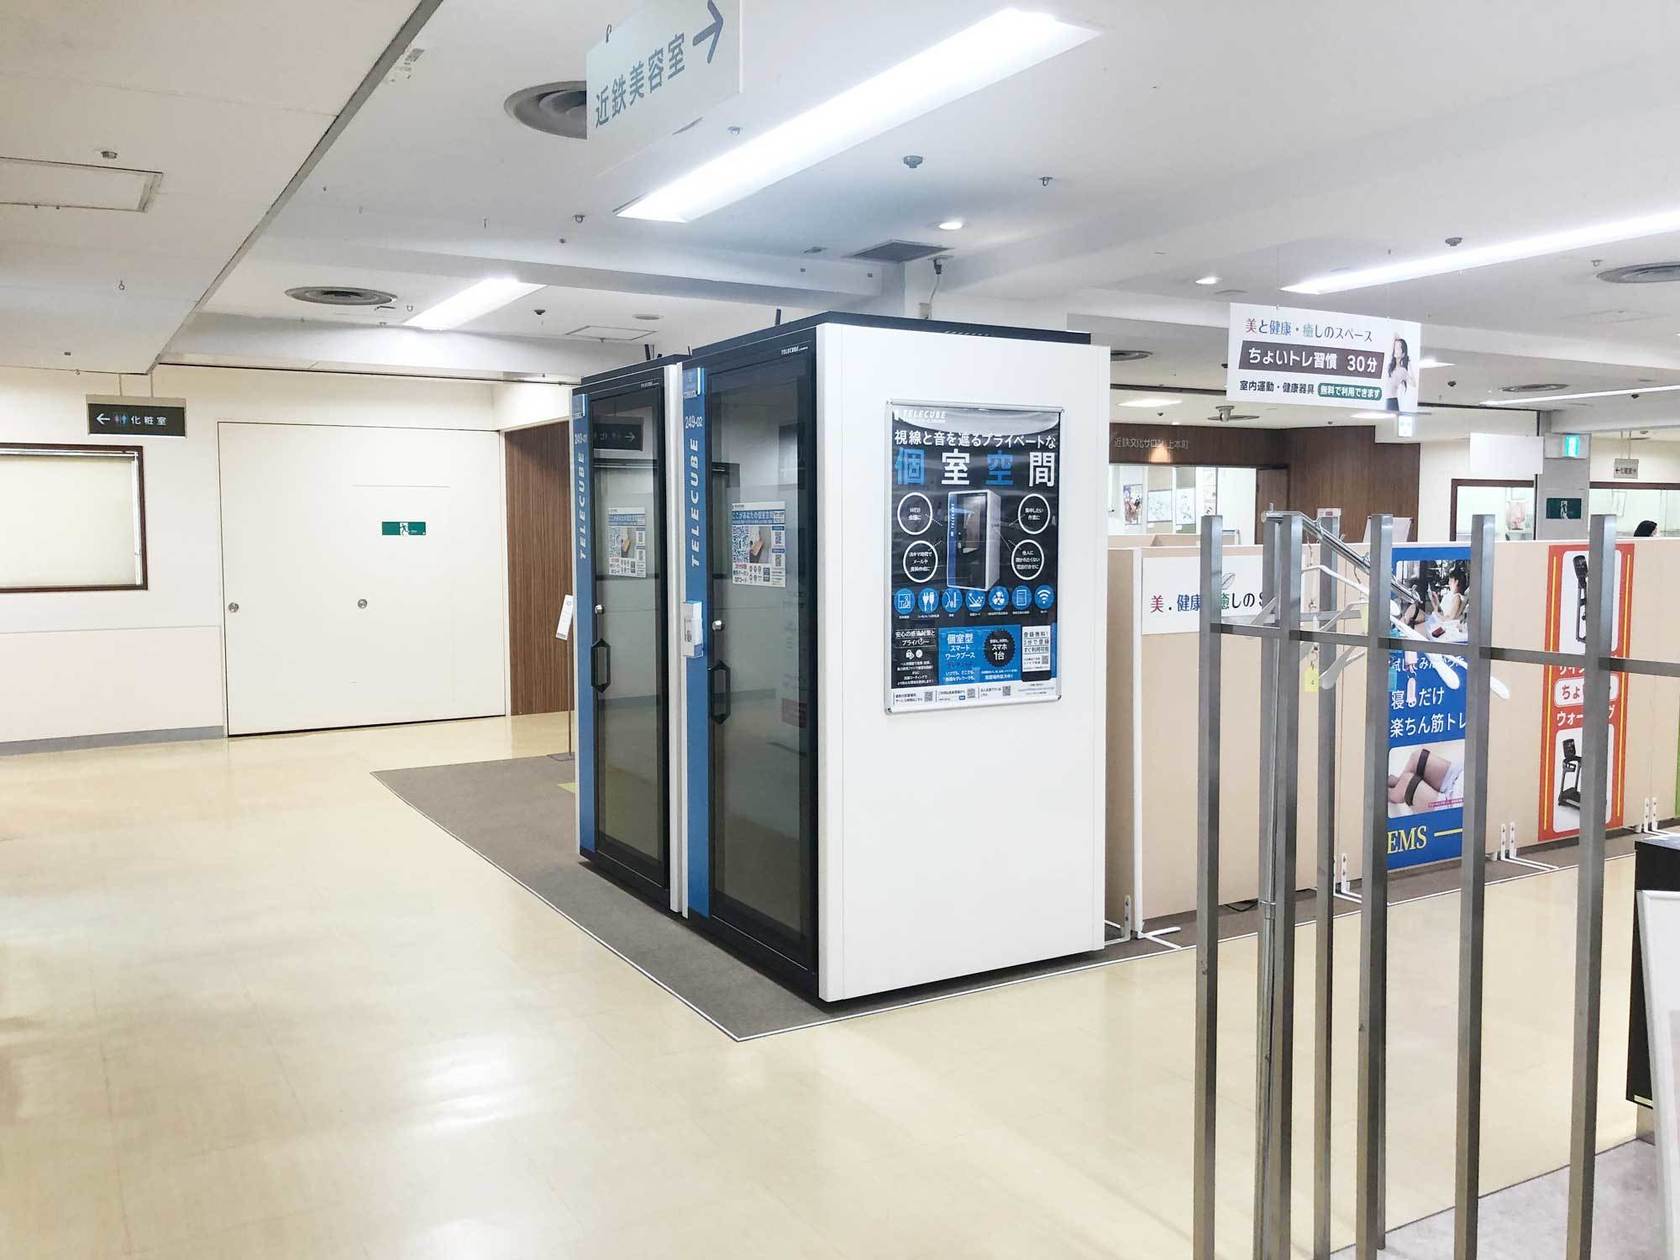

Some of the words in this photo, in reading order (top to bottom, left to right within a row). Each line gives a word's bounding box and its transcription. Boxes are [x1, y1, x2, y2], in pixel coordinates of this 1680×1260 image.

[595, 32, 685, 128] 近鉄美容室
[1246, 318, 1373, 342] 美と健康・癒しのスペース
[1248, 347, 1338, 370] ちょいトレ習慣
[1347, 354, 1378, 373] 30分
[1239, 380, 1315, 395] 室内運動・健康器具
[130, 415, 168, 426] 化粧室
[685, 415, 703, 428] 249-02
[894, 429, 1056, 449] 視線と音を遮るプライベートな
[895, 447, 1056, 487] 個室空間
[578, 452, 586, 560] TELECUBE
[690, 439, 700, 567] TELECUBE
[947, 632, 974, 645] 個室型
[950, 644, 970, 652] スマート
[992, 643, 1007, 651] スマホ
[993, 651, 1005, 661] 1台
[1390, 712, 1466, 738] 楽ちん筋トレ
[1386, 825, 1428, 854] EMS
